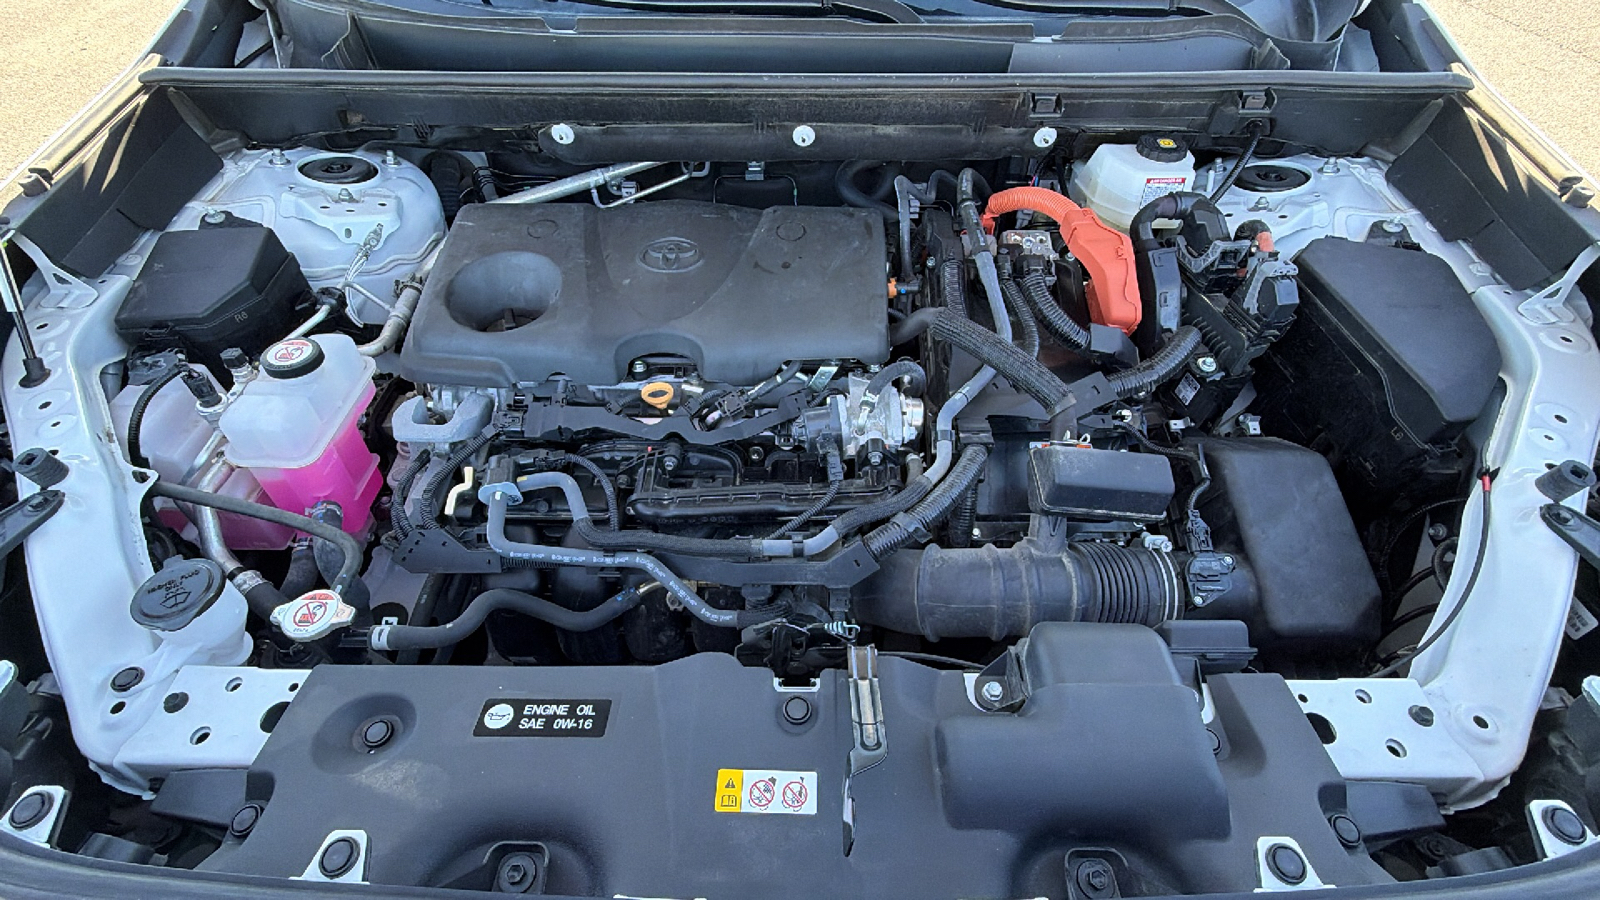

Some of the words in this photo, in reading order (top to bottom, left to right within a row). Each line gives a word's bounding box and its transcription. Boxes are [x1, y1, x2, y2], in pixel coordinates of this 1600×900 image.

[523, 704, 570, 715] ENGINE
[576, 704, 596, 716] OIL
[518, 718, 546, 729] SAE
[552, 718, 593, 730] 0W-16
